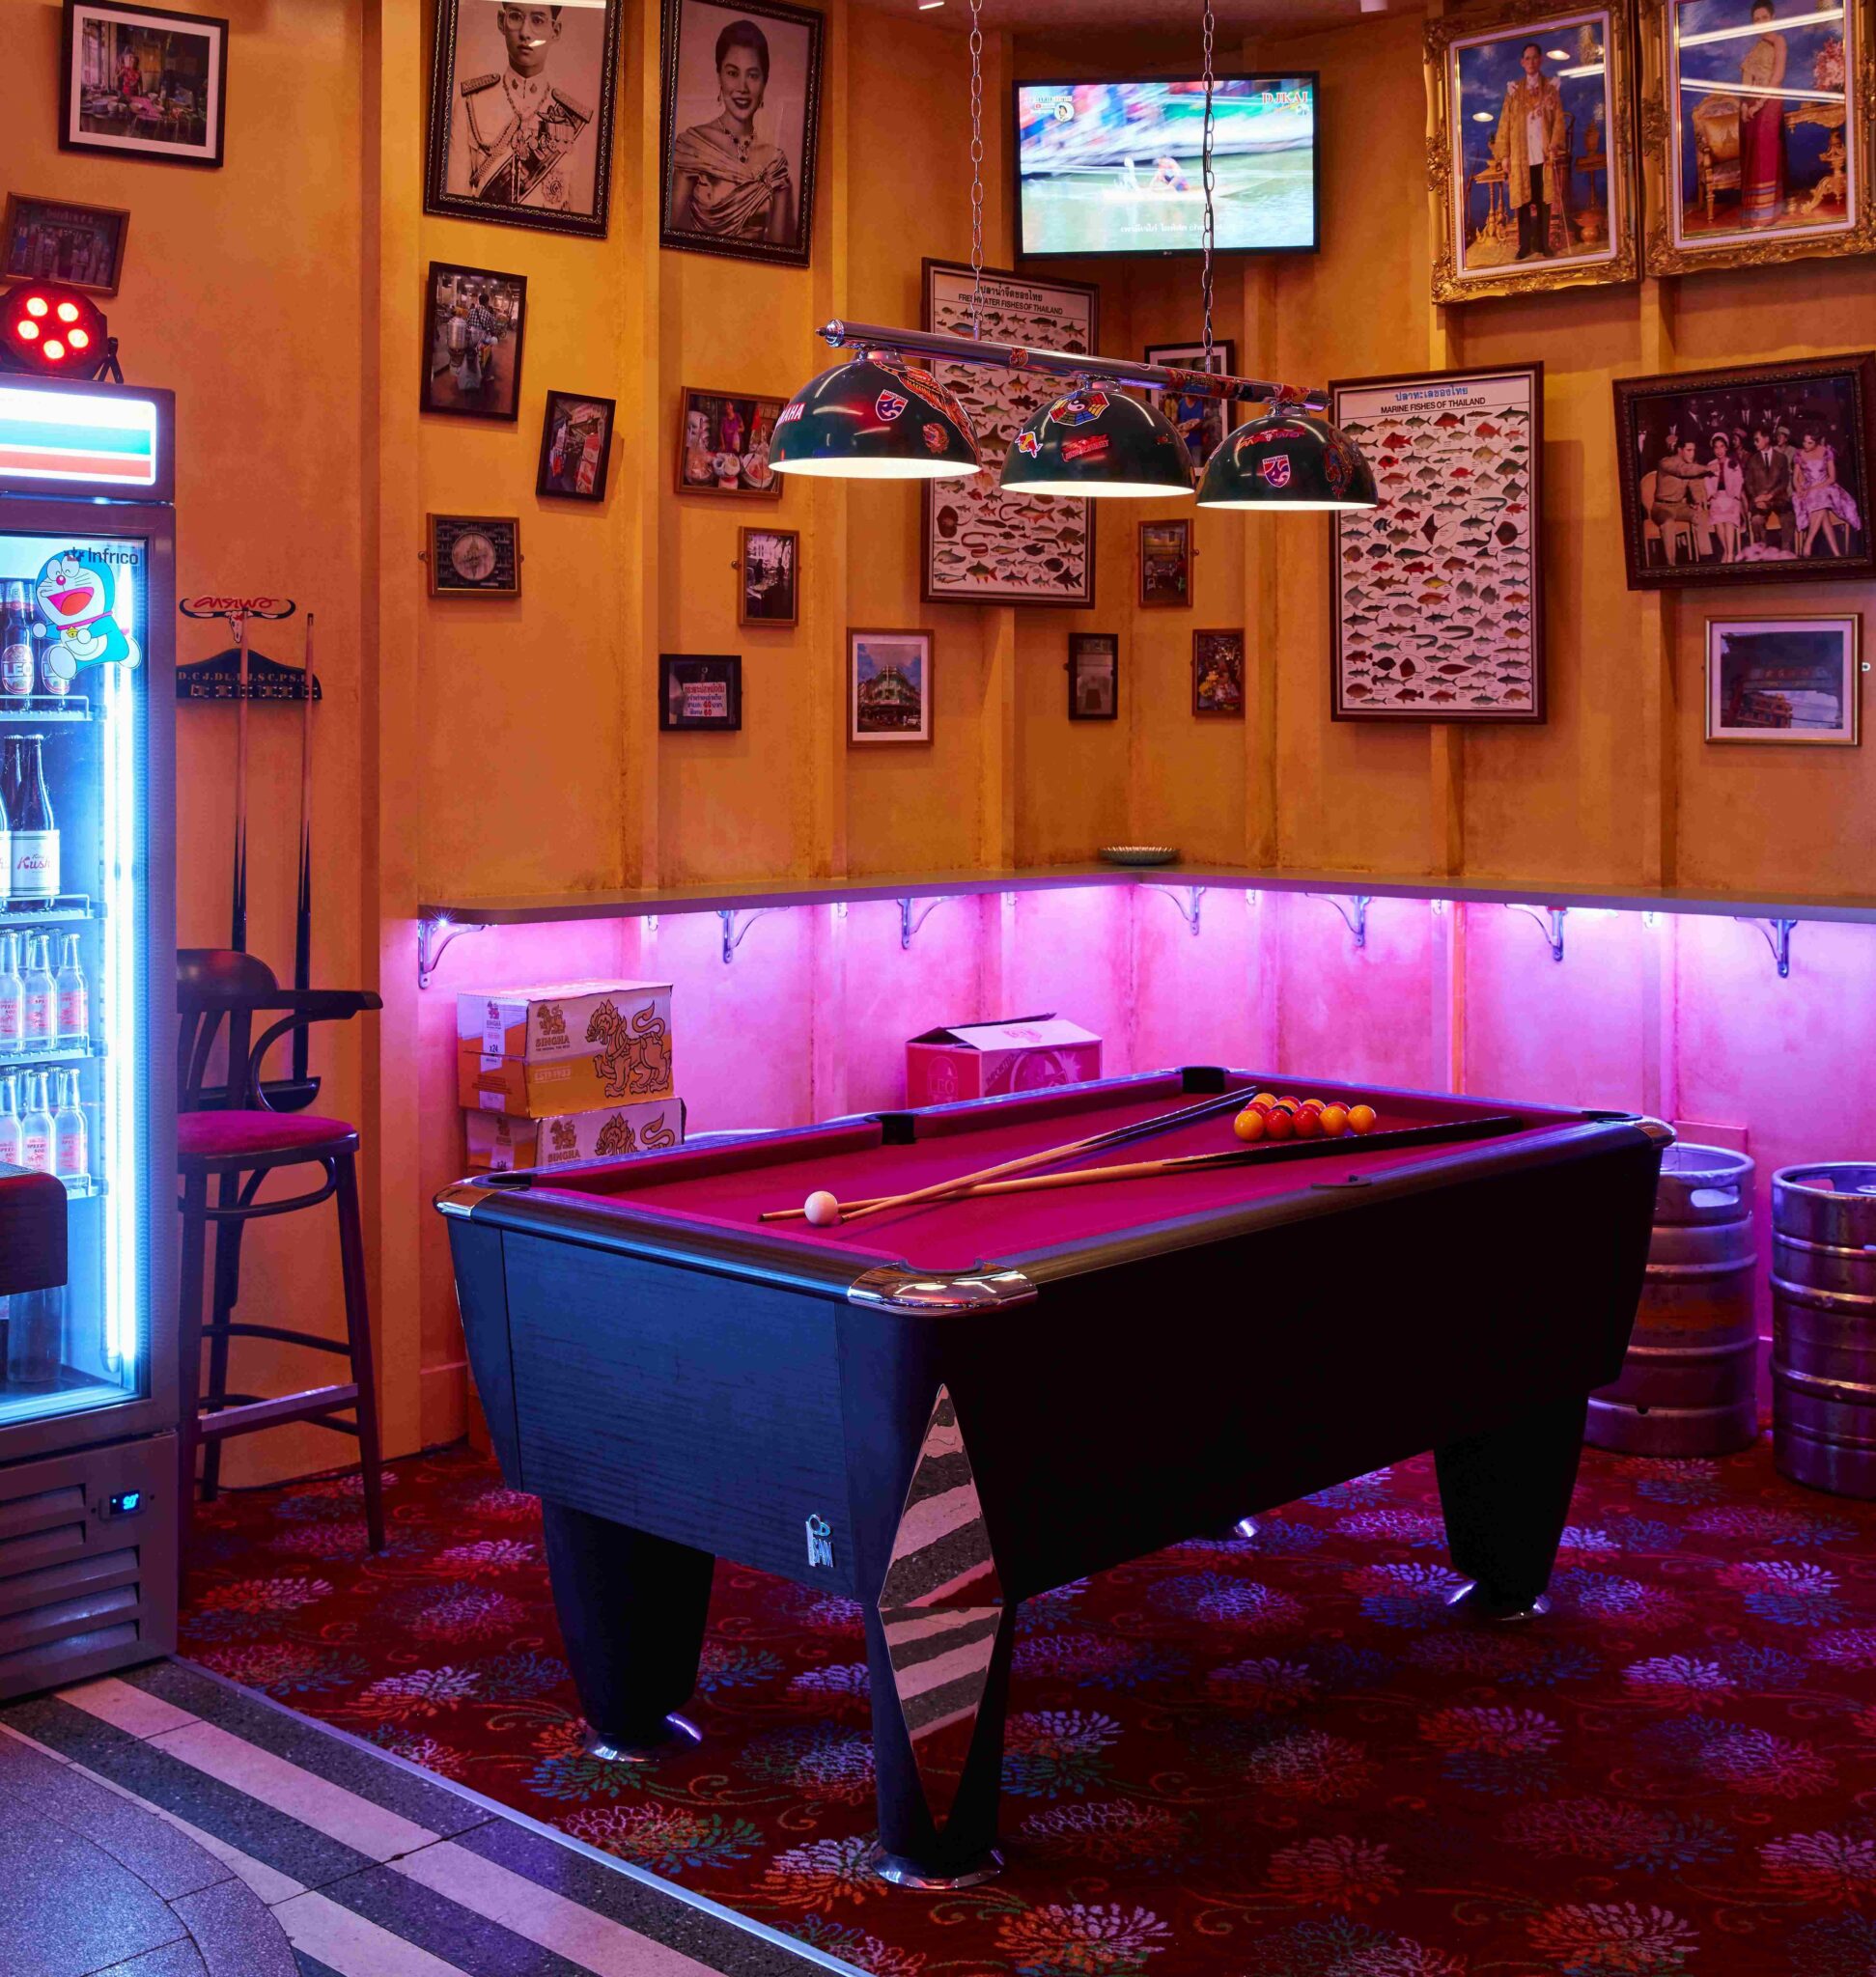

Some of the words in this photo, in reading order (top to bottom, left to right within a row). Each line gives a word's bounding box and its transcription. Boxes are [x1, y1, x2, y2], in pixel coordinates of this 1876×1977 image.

[1001, 299, 1022, 310] FISHES
[1023, 302, 1033, 311] OF
[1033, 303, 1064, 316] THAILAND
[1395, 385, 1469, 402] ปลาทะเลของไทย
[1381, 404, 1409, 414] MARINE
[1410, 402, 1436, 411] FISHES
[1436, 400, 1446, 409] OF
[1448, 397, 1486, 407] THAILAND
[88, 547, 139, 565] Infrico
[3, 662, 32, 677] LEO
[535, 1035, 571, 1047] SINGHA
[548, 1150, 580, 1163] SINGHA
